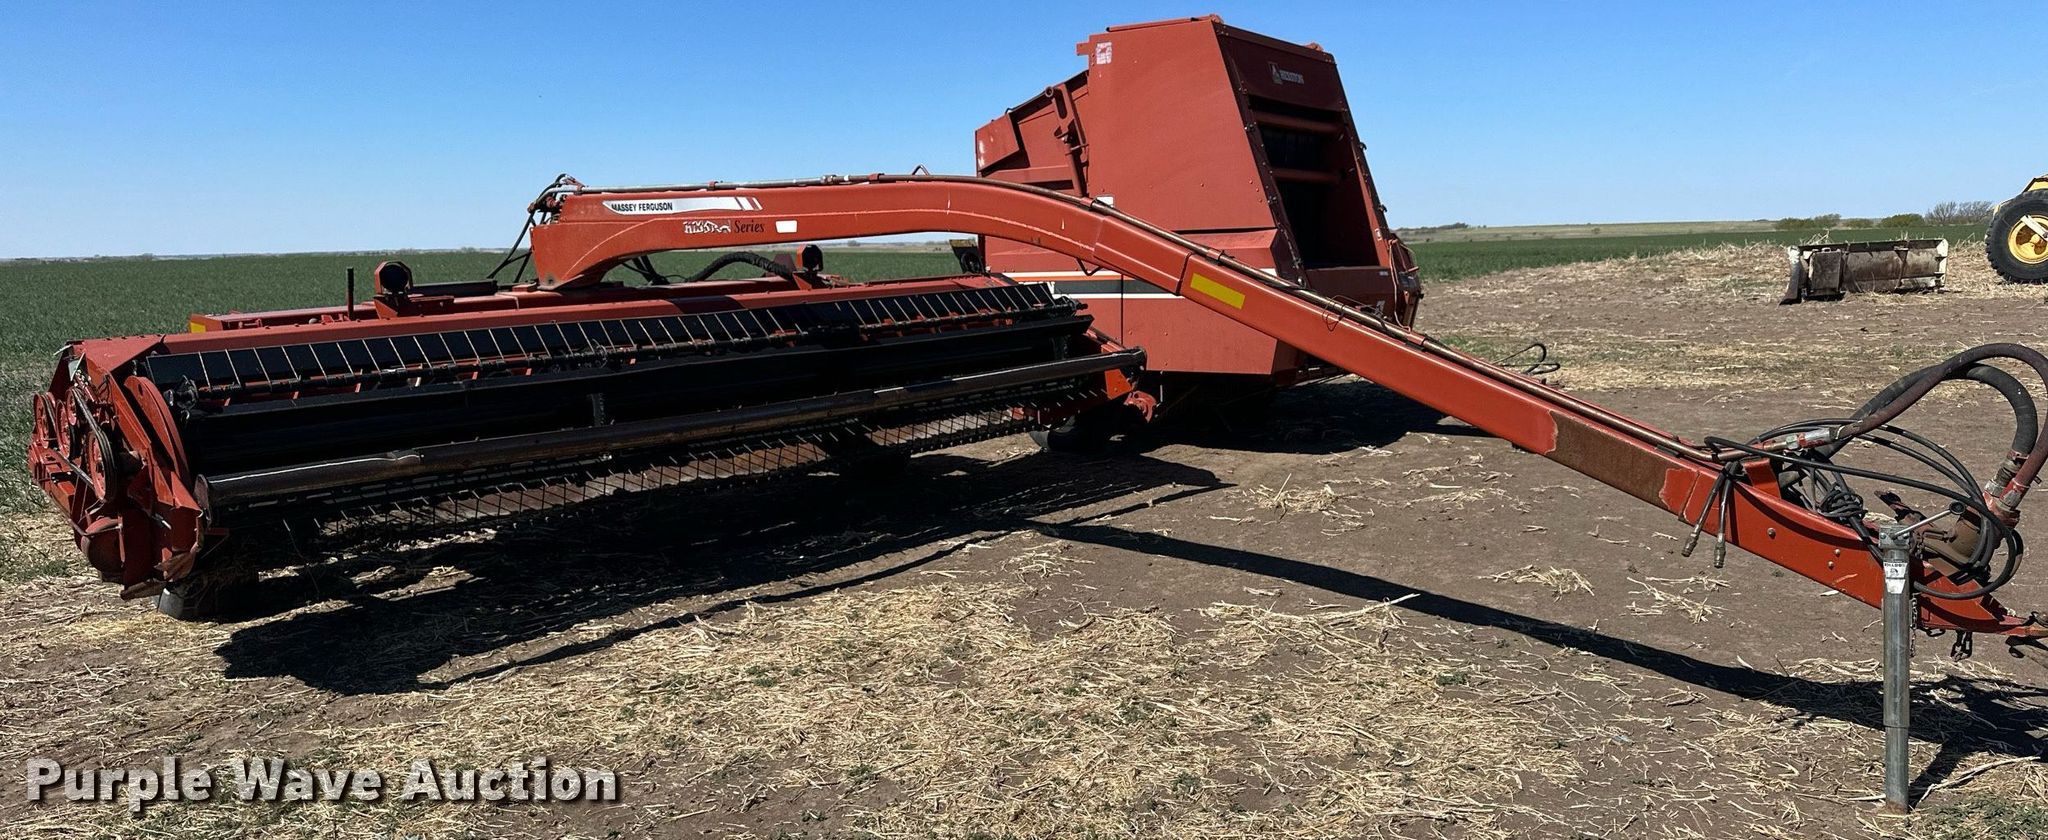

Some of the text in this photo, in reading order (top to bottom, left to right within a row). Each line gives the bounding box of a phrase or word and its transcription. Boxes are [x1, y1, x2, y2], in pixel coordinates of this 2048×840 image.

[611, 203, 637, 212] MASSEY
[638, 202, 673, 211] FERGUSON
[734, 220, 765, 233] Series
